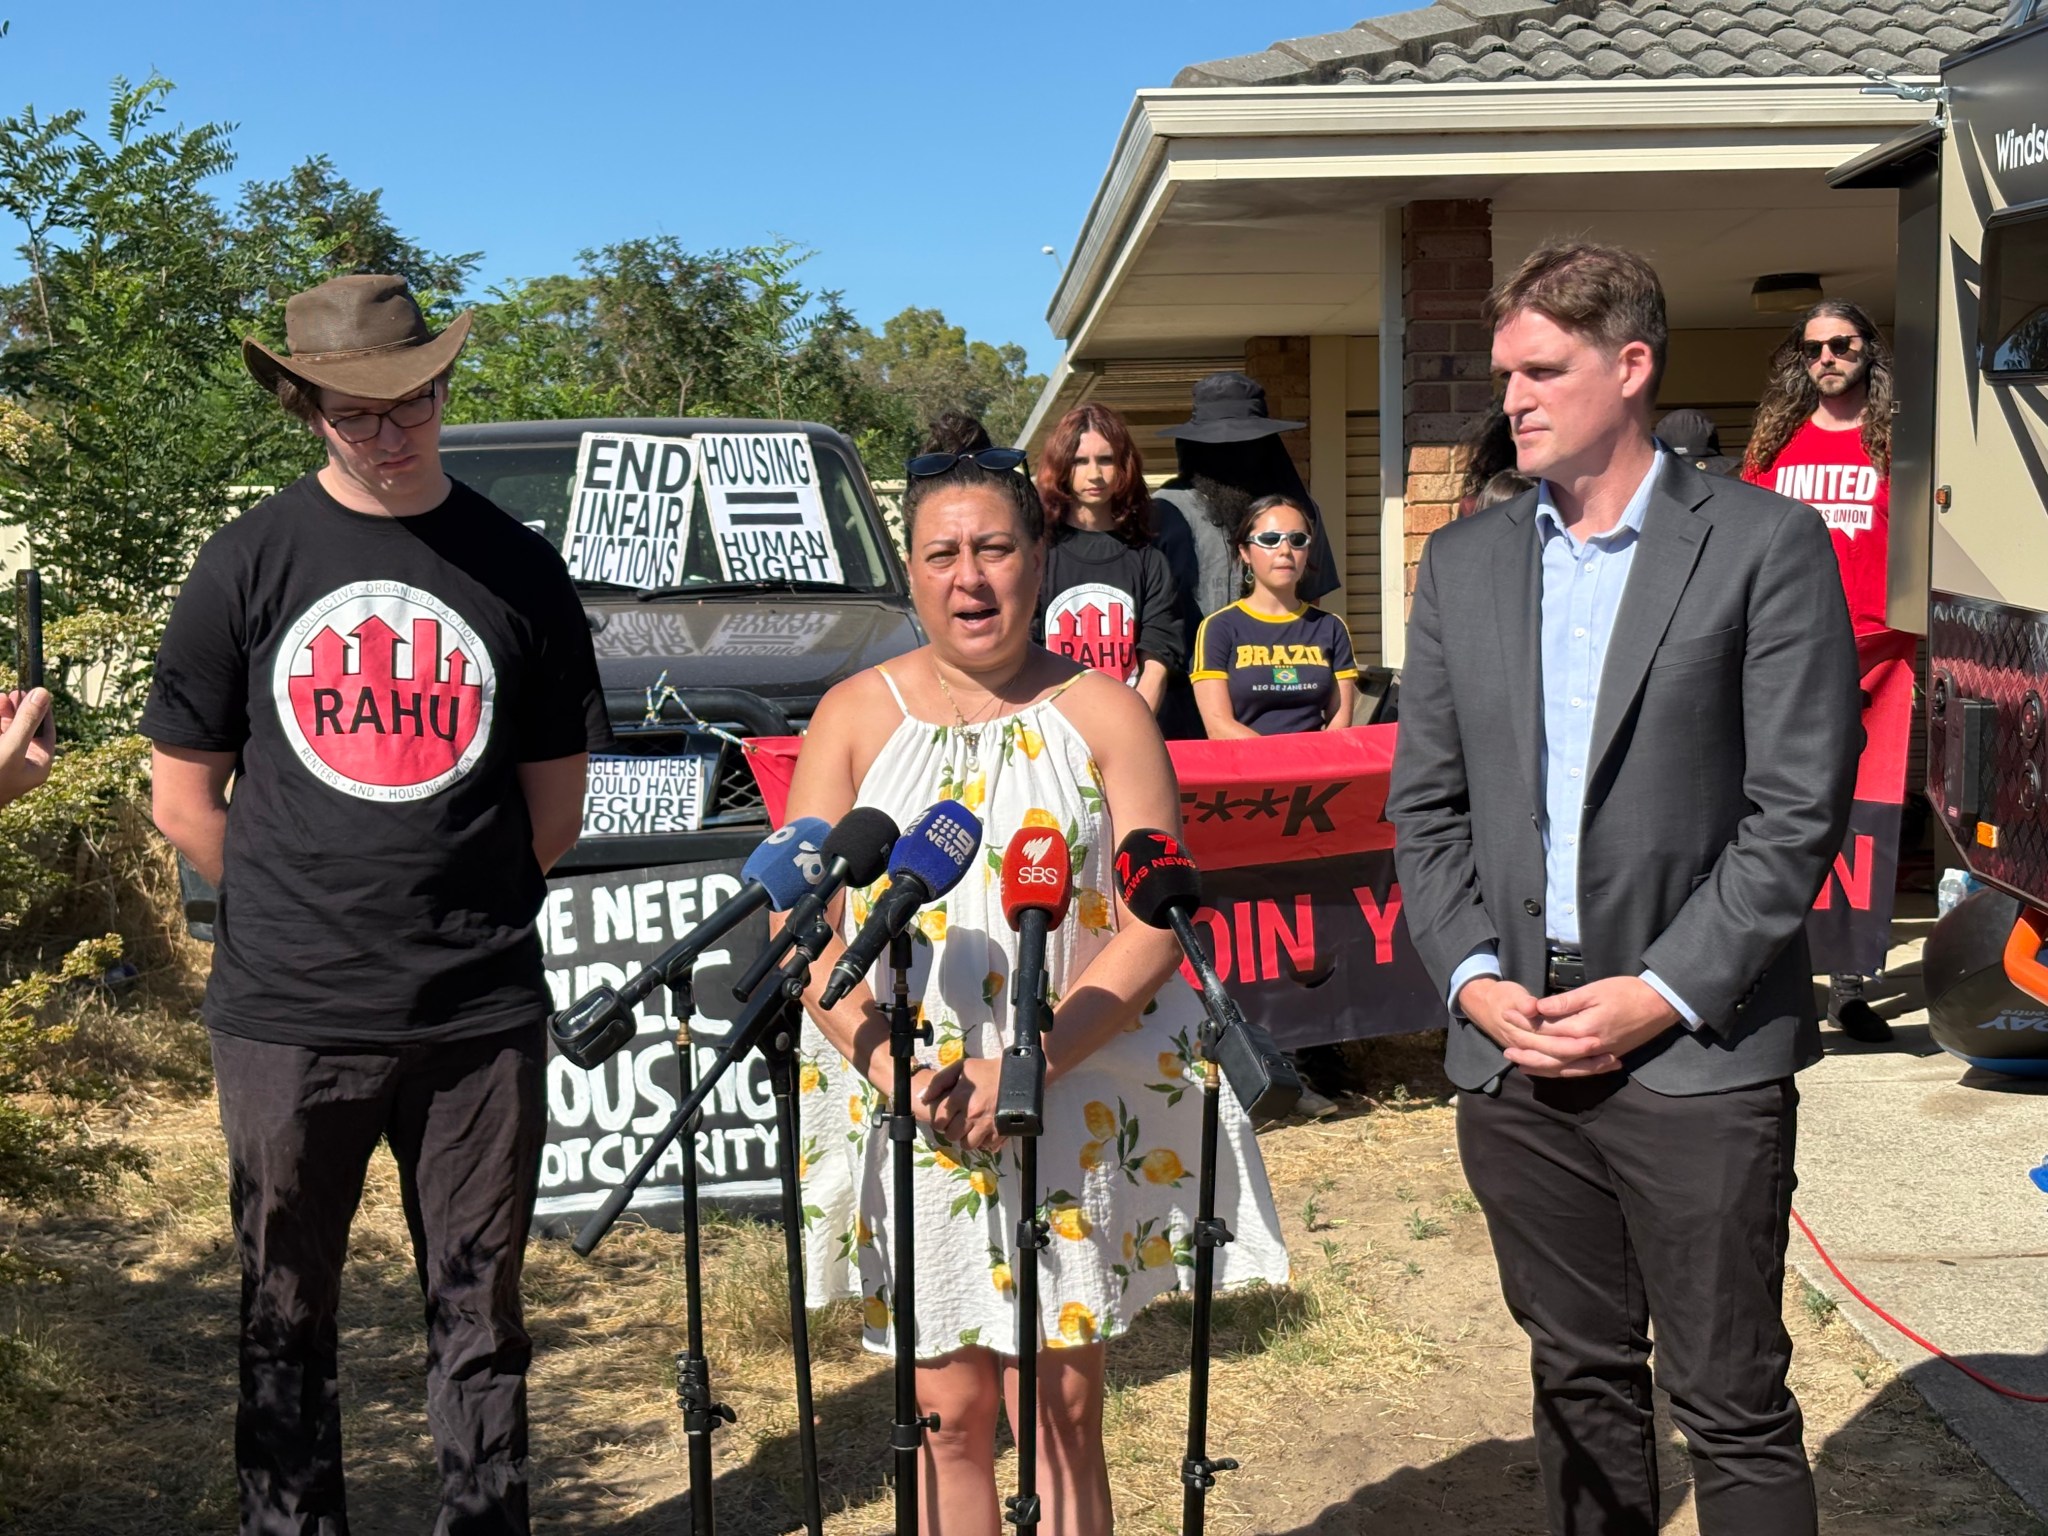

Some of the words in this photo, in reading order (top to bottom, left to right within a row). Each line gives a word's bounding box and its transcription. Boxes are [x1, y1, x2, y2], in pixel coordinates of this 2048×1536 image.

[583, 438, 691, 494] END
[700, 437, 810, 486] HOUSING
[1775, 464, 1878, 501] UNITED
[575, 491, 684, 540] UNFAIR
[1833, 508, 1867, 525] UNION
[567, 535, 679, 588] EVICTIONS
[720, 530, 829, 558] HUMAN
[728, 554, 830, 582] RIGHT
[294, 584, 356, 636] COLLECTIVE
[366, 582, 435, 607] ORGANISED
[441, 608, 479, 646] ACTION
[1235, 645, 1329, 669] BRAZIL
[1282, 683, 1318, 691] JANEIRO
[313, 686, 460, 742] RAHU
[300, 747, 339, 785] RENTERS
[350, 784, 375, 798] AND
[389, 780, 442, 800] HOUSING
[449, 755, 474, 782] UNION
[588, 757, 620, 776] GLE
[624, 757, 697, 777] MOTHERS
[586, 776, 641, 795] OULD
[646, 777, 697, 797] HAVE
[588, 796, 696, 817] ECURE
[925, 828, 966, 866] NEWS
[1151, 856, 1196, 869] NEWS
[1018, 866, 1058, 885] SBS
[1178, 894, 1315, 991] OIN
[547, 1040, 778, 1135] OUSNG
[539, 1137, 591, 1188] OT
